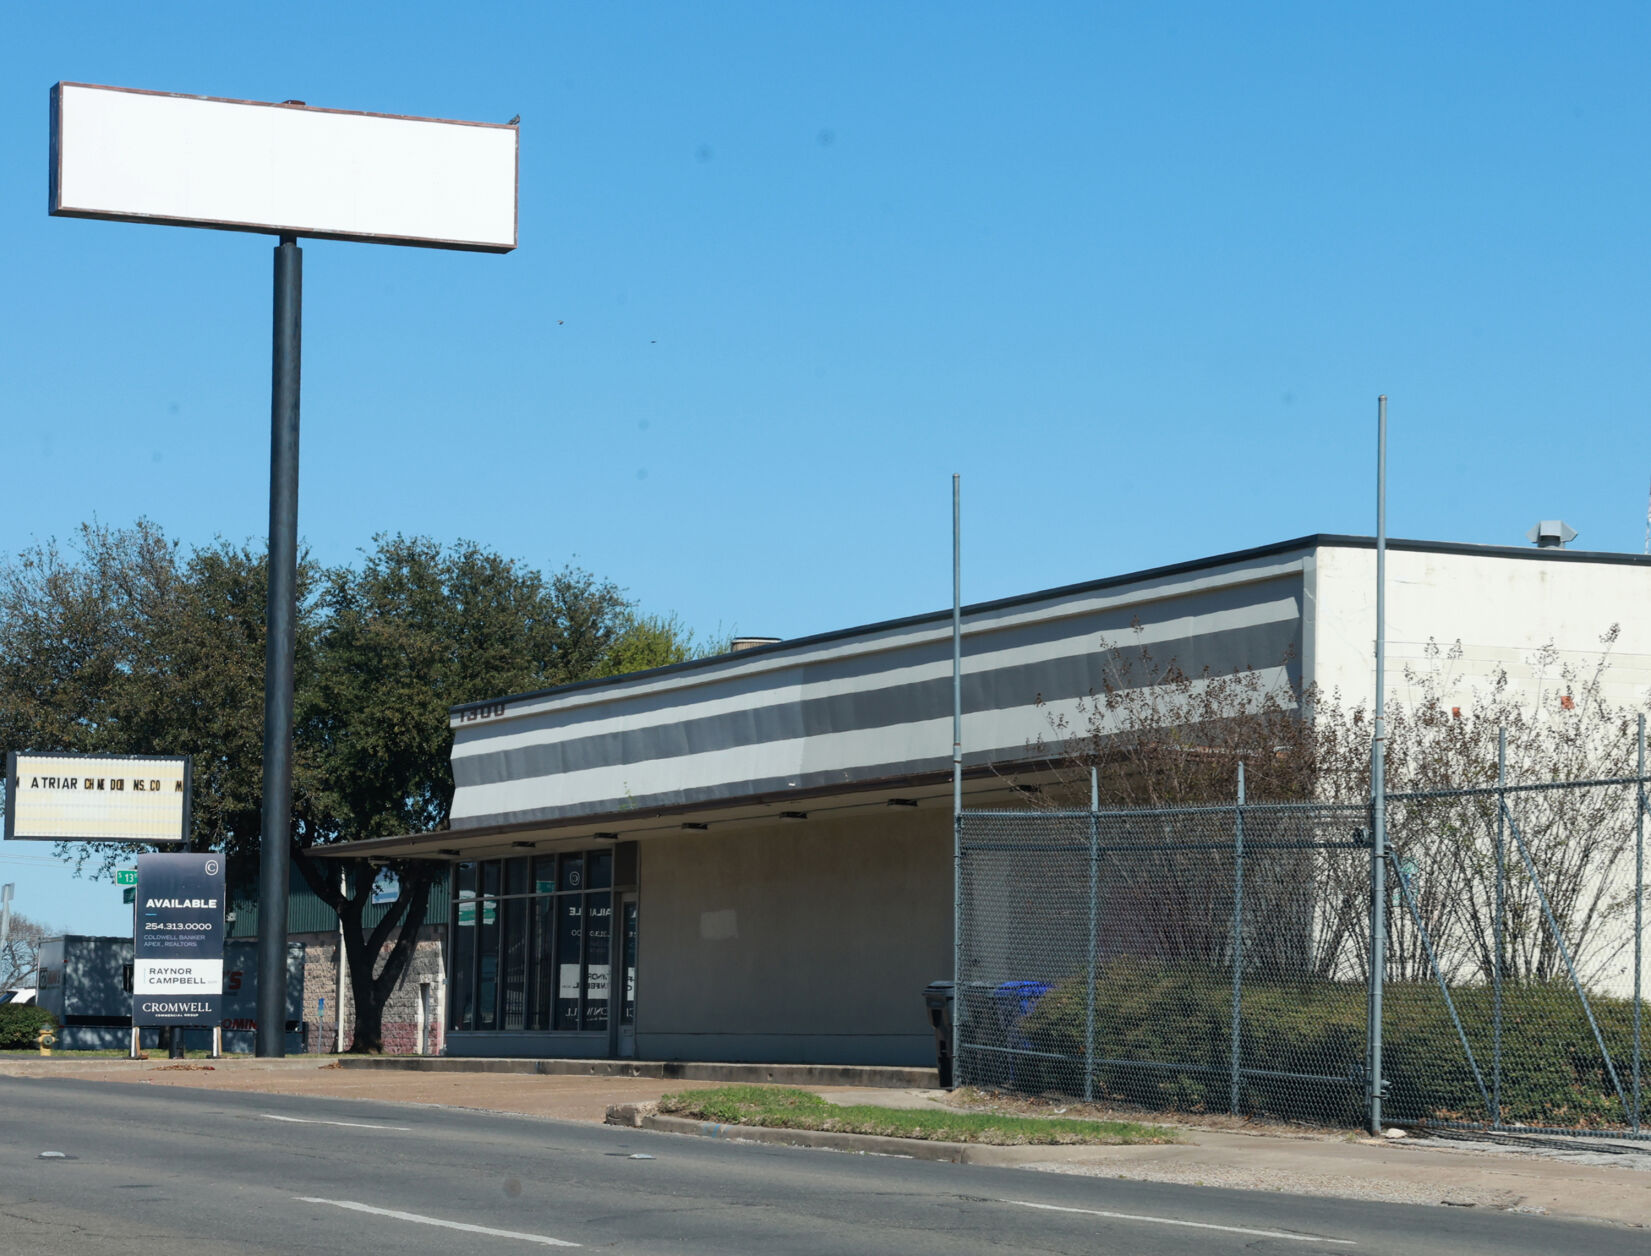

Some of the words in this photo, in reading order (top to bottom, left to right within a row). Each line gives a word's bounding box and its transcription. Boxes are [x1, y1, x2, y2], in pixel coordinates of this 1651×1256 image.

[146, 898, 217, 909] AVAILABLE
[145, 922, 212, 931] 254.313.0000
[149, 967, 193, 976] RAYNOR
[148, 976, 206, 985] CAMPBELL
[142, 1002, 213, 1013] CROMWELL
